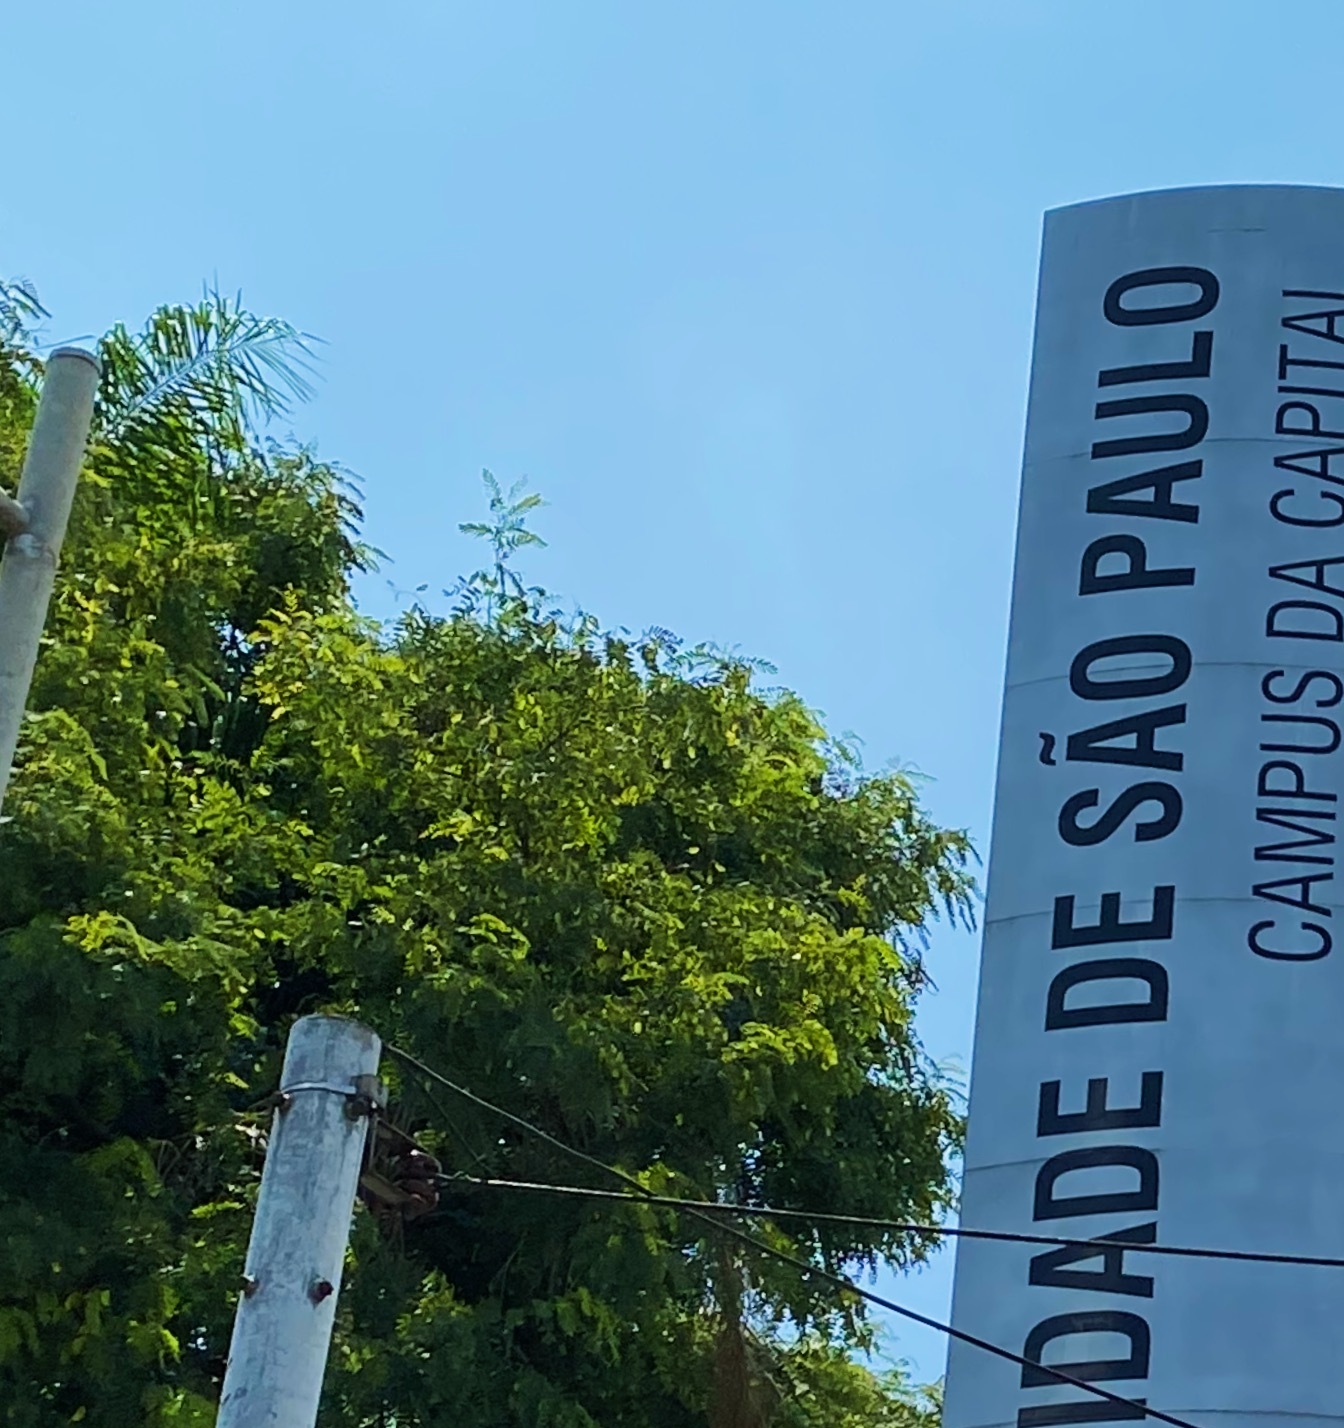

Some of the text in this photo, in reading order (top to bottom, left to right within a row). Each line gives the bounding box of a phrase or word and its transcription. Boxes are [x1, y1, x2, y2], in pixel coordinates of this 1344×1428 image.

[1078, 266, 1220, 596] PAULO
[1039, 634, 1192, 847] SÃO
[1248, 670, 1344, 962] CAMPUS
[1045, 885, 1176, 1032] DE
